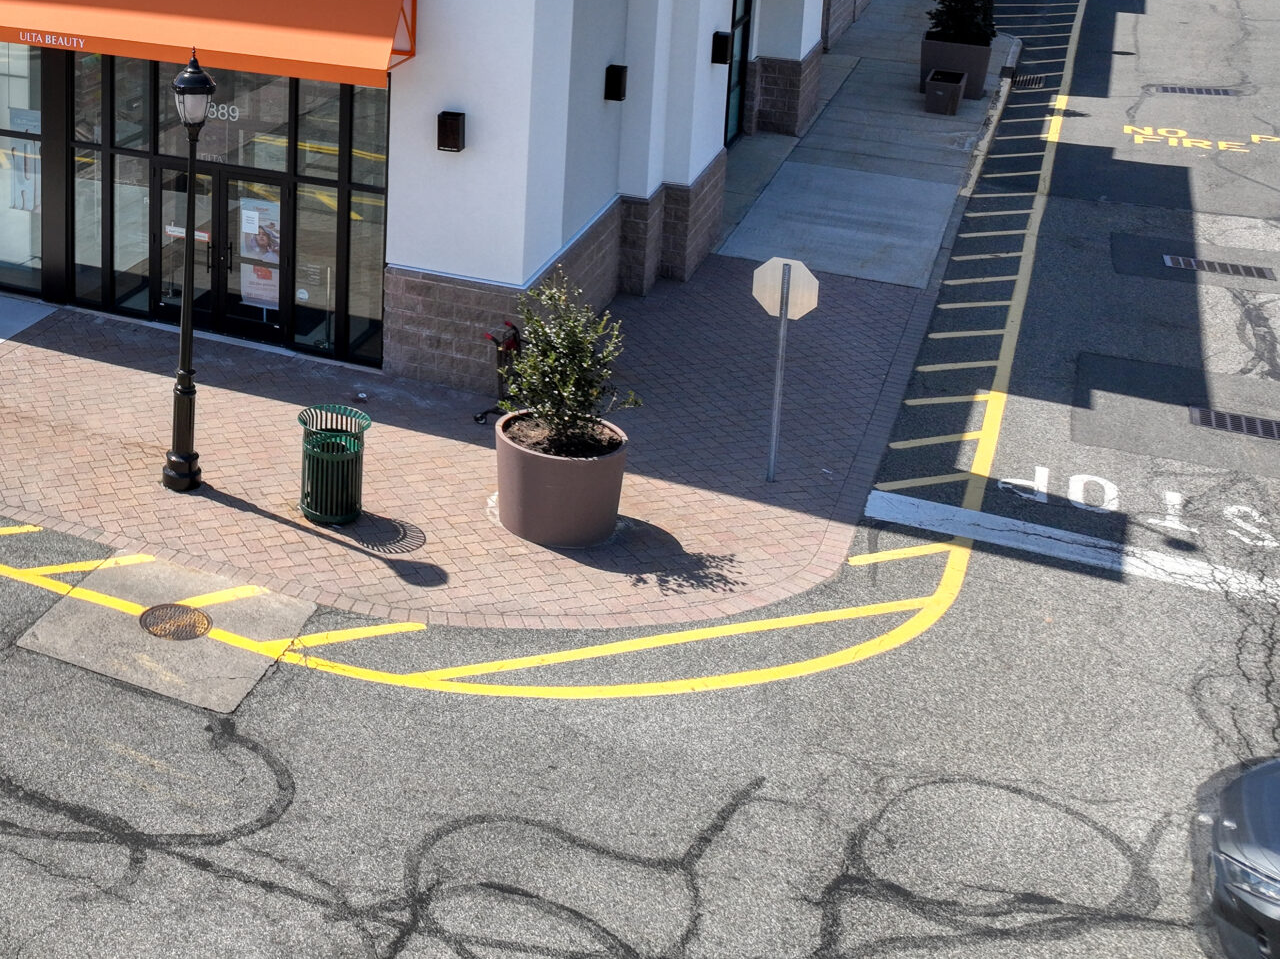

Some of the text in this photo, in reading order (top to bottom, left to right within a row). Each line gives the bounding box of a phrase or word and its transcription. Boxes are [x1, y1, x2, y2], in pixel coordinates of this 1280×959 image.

[19, 31, 86, 49] ULTA BEAUTY
[1123, 124, 1189, 138] NO
[1133, 134, 1251, 153] FIRE
[997, 465, 1280, 547] STOP
